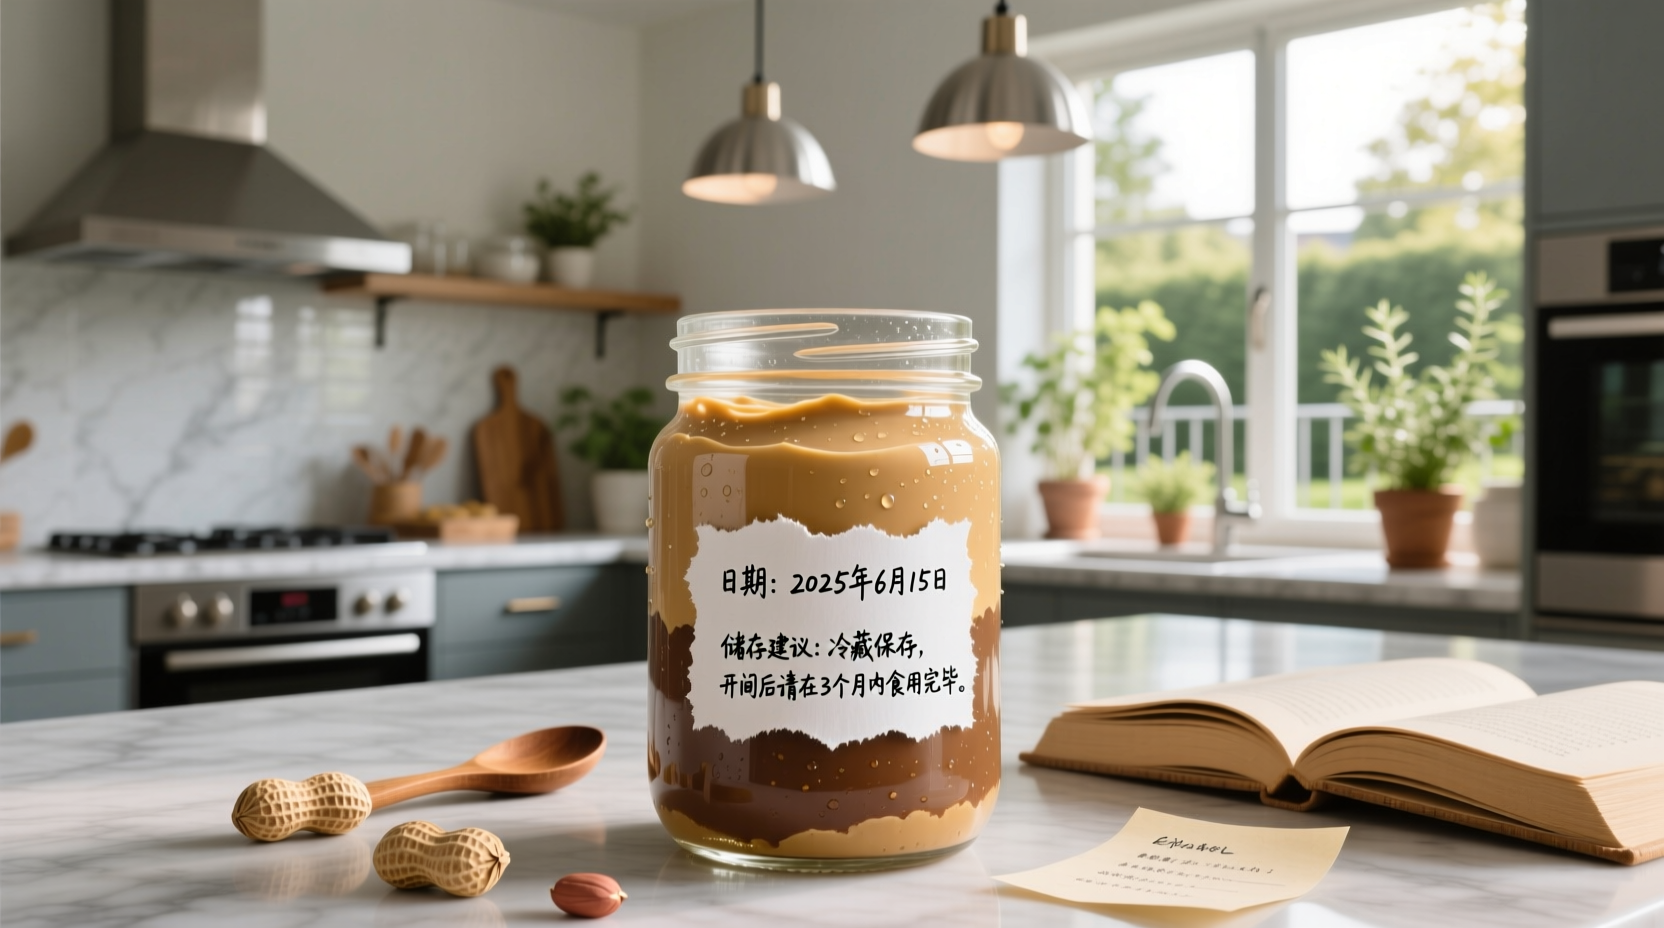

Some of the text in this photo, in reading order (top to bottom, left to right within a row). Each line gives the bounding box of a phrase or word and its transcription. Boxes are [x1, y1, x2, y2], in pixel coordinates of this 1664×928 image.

[719, 665, 966, 701] 开间后请在3个月内食用完毕。
